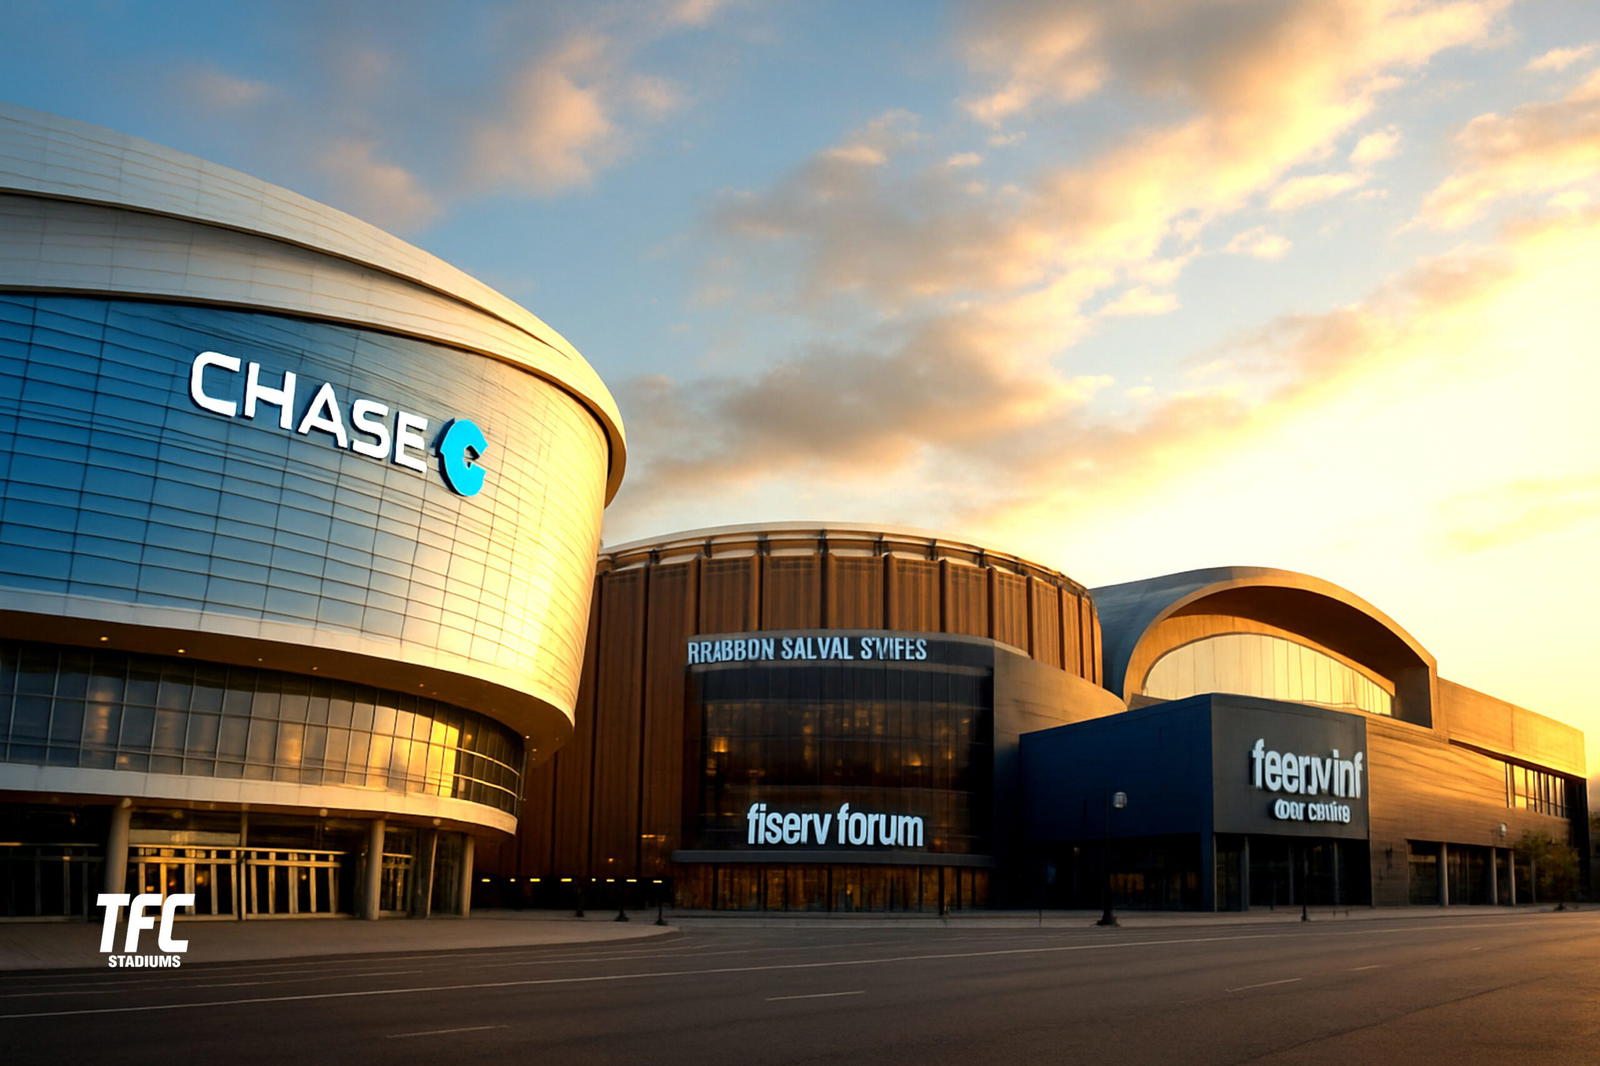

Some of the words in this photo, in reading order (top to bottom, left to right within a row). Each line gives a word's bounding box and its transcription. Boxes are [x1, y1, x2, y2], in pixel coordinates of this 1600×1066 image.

[190, 351, 429, 474] CHASE
[781, 637, 853, 660] SALVAL
[747, 803, 832, 844] fiserv
[837, 803, 924, 846] forum
